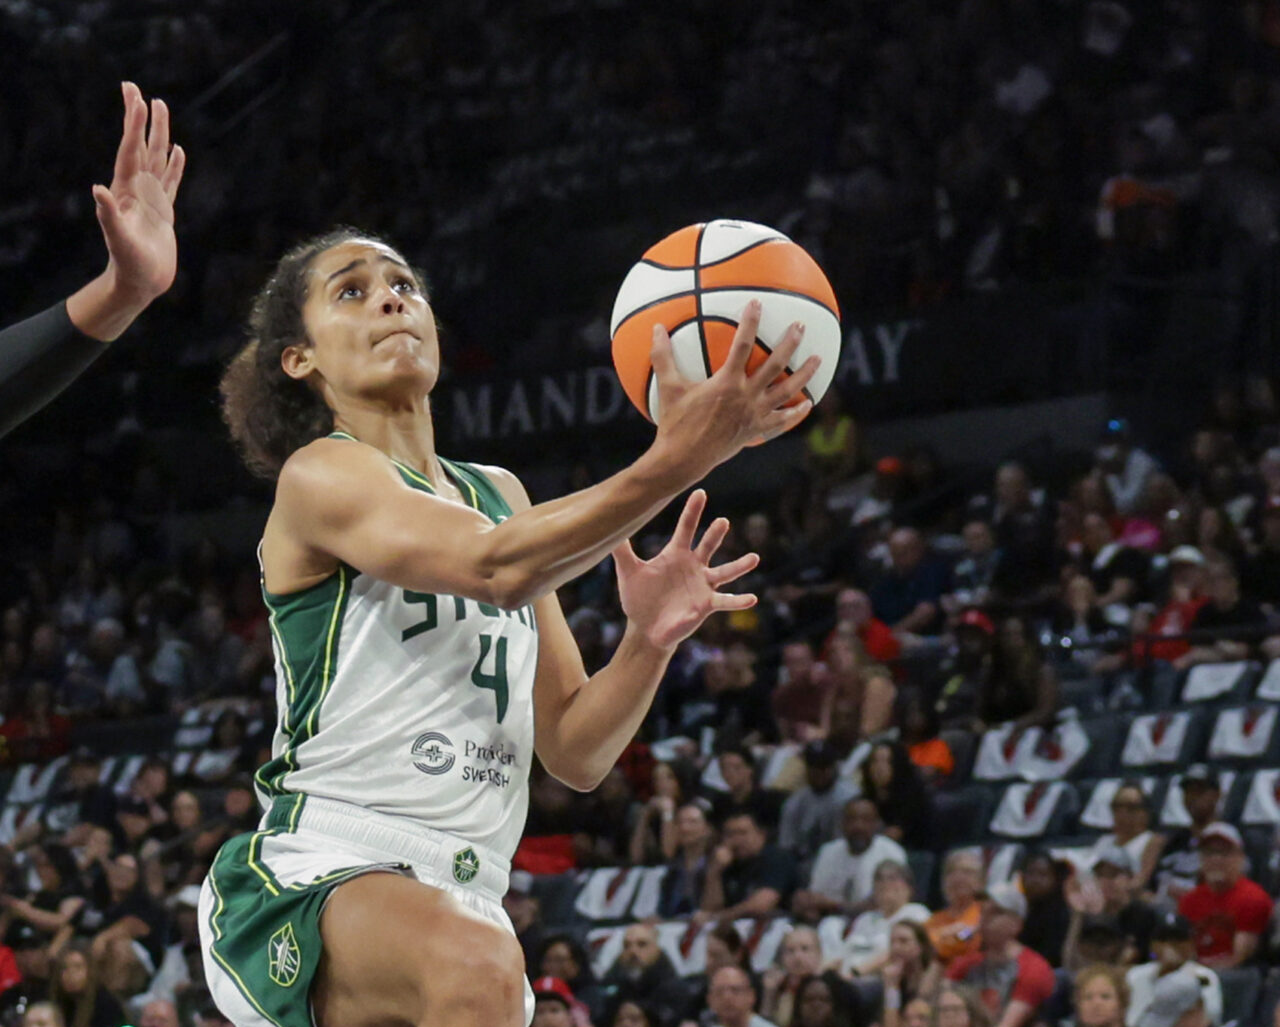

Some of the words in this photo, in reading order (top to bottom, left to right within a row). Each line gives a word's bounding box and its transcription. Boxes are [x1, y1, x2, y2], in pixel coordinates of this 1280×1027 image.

[451, 366, 629, 441] MAND
[835, 319, 914, 385] AY
[471, 634, 509, 724] 4
